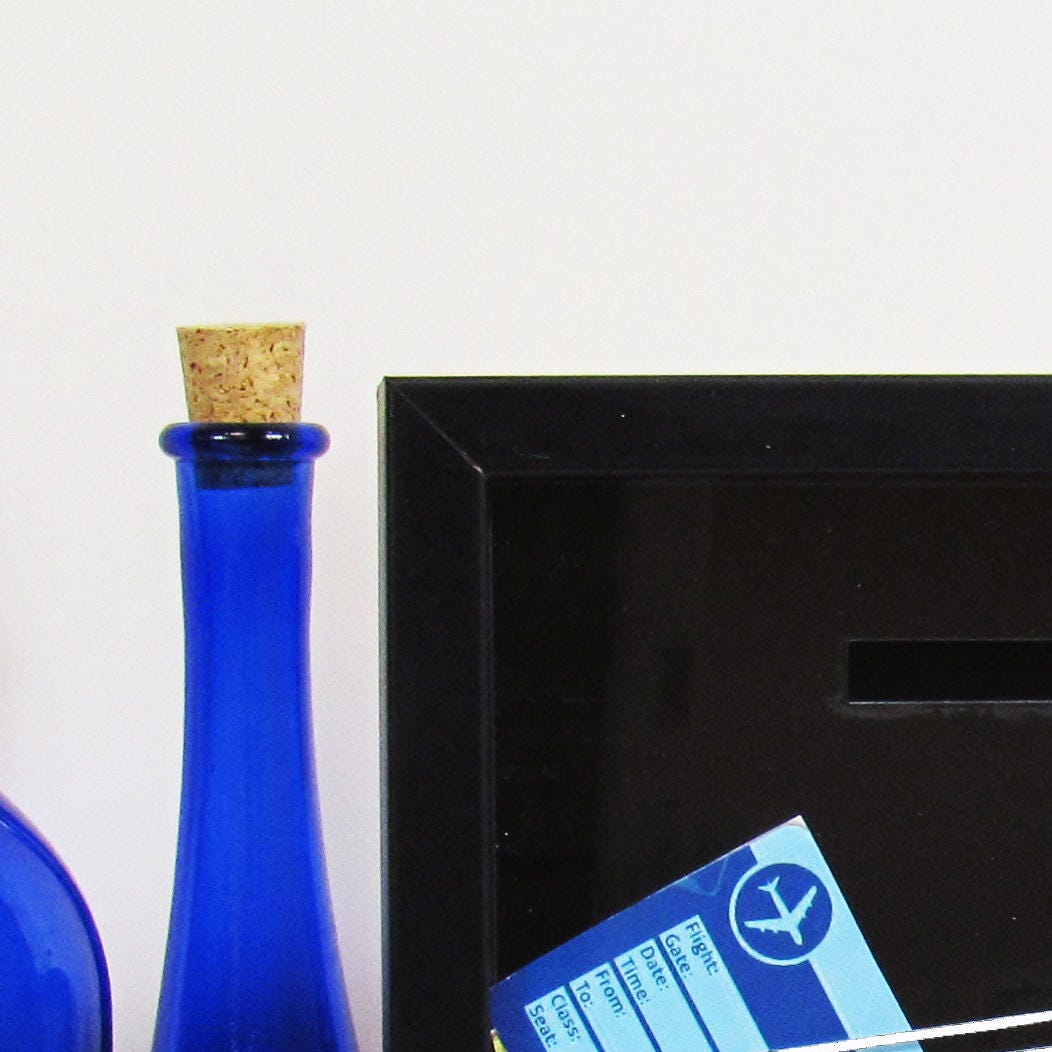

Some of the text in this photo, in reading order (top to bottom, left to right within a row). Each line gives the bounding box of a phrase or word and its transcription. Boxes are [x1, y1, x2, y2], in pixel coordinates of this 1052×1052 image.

[640, 946, 670, 992] Date:
[665, 933, 695, 979] Gate:
[686, 921, 719, 977] Flight:
[574, 981, 593, 1009] To:
[594, 968, 627, 1019] From:
[616, 957, 652, 1006] Time:
[529, 1005, 557, 1049] Seat:
[550, 993, 583, 1043] Class:
